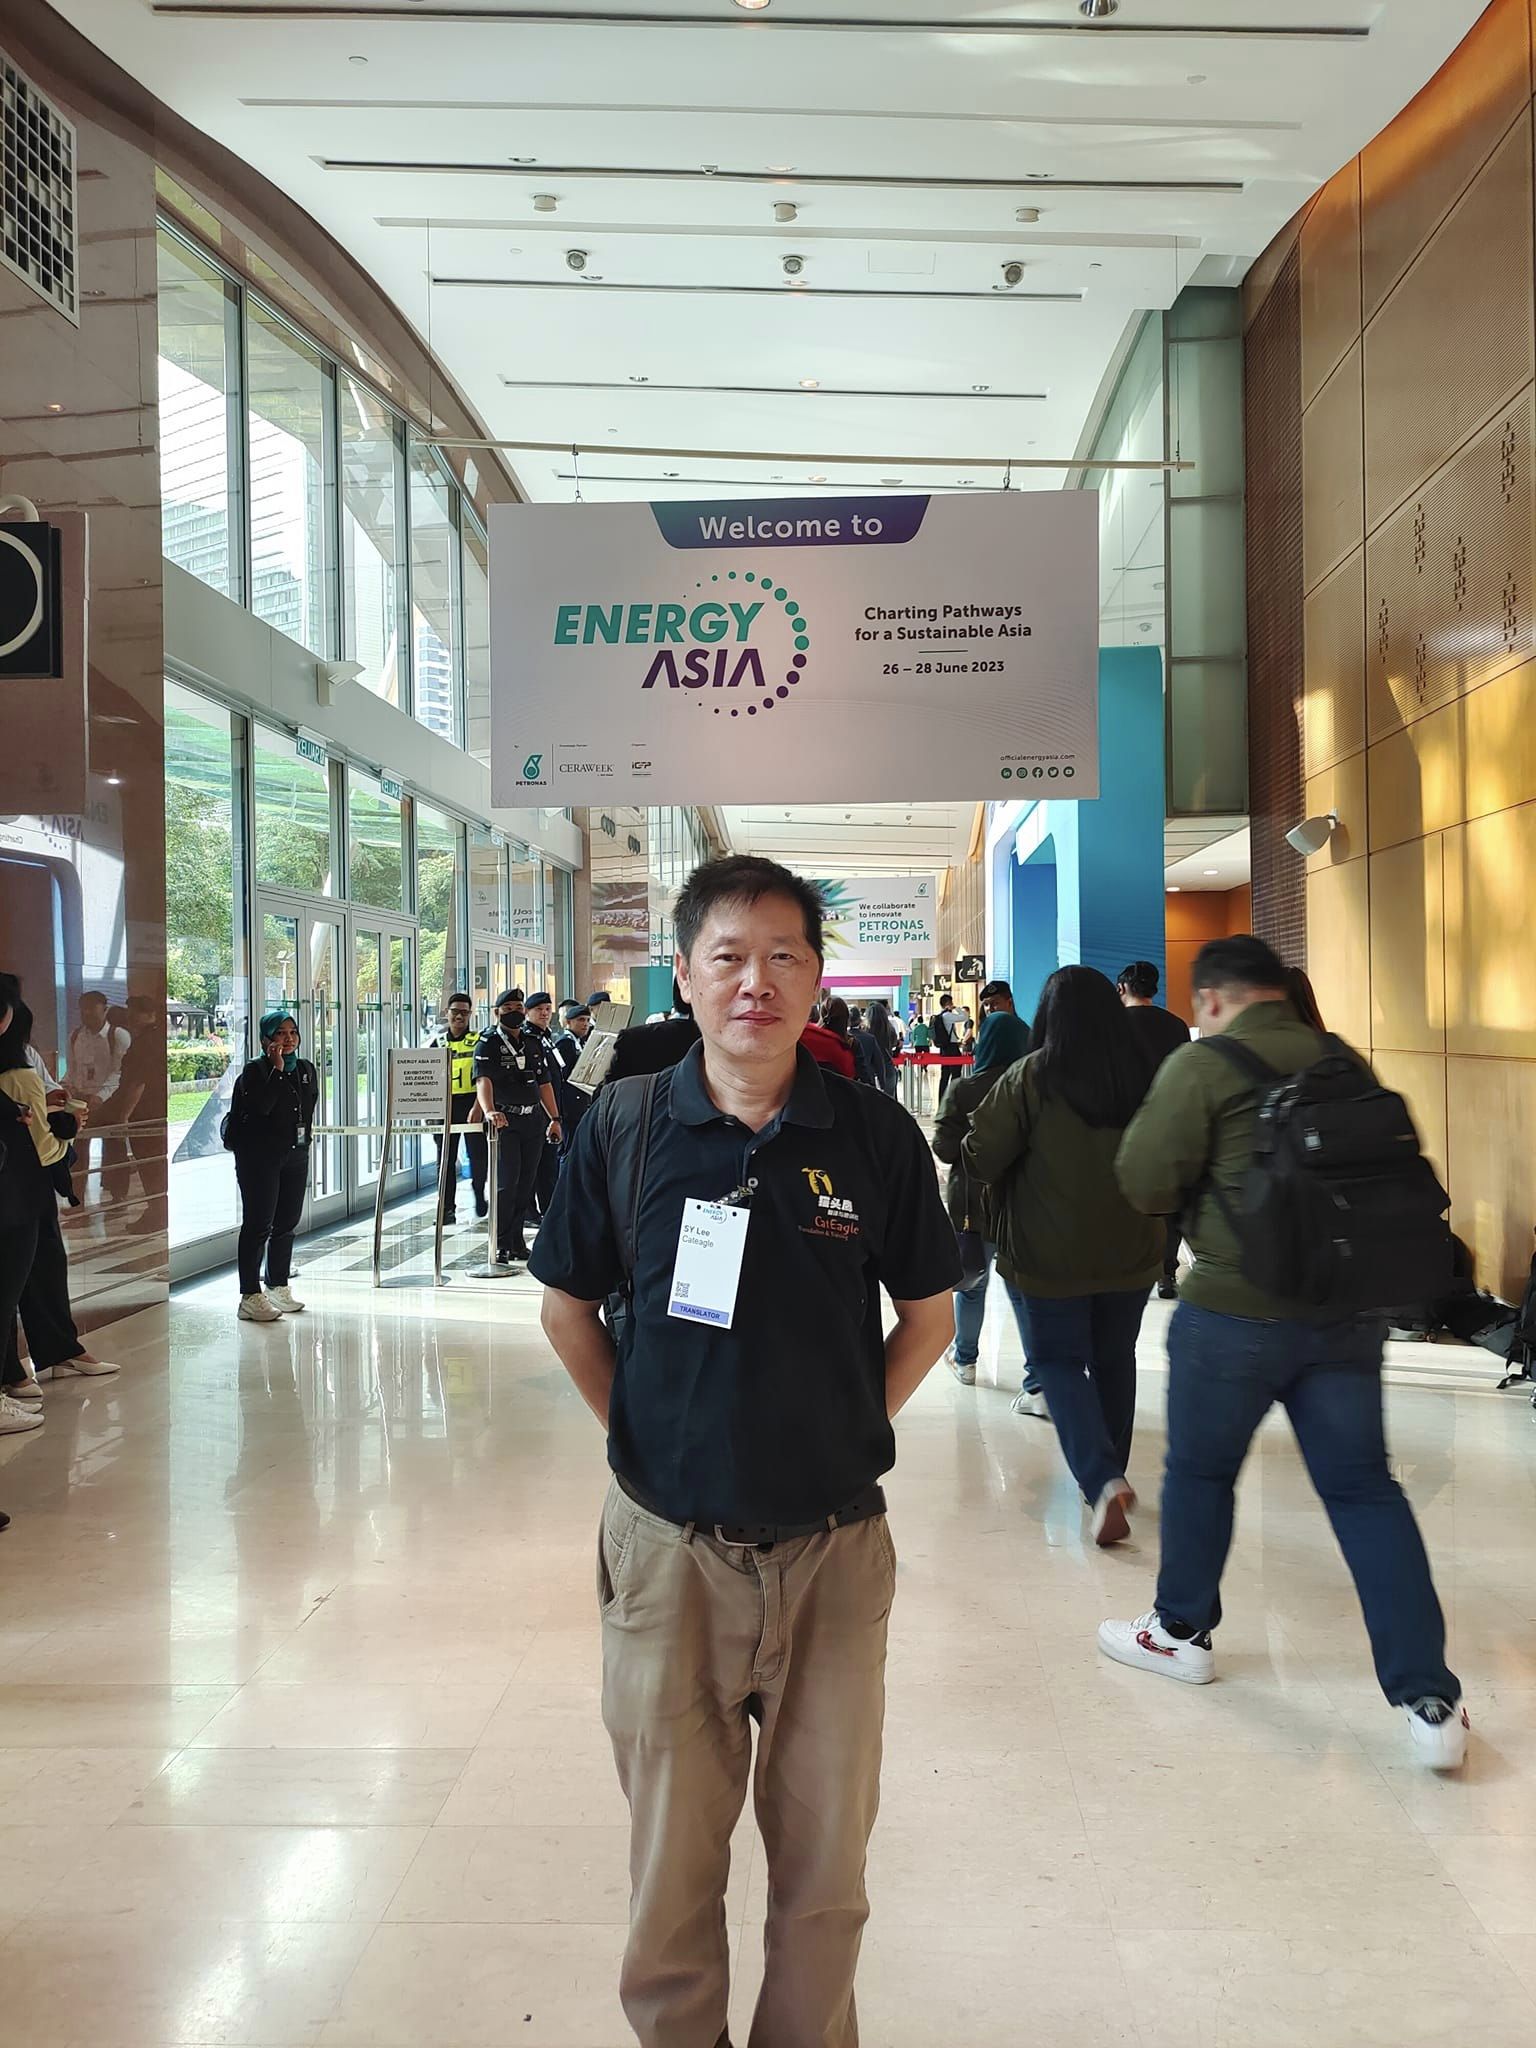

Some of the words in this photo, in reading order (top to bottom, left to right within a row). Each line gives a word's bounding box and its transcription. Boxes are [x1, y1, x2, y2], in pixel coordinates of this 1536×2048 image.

[698, 514, 841, 541] Welcome
[851, 514, 883, 537] to
[864, 606, 938, 621] Charting
[942, 604, 1022, 620] Pathways
[553, 602, 765, 645] ENERGY
[855, 627, 880, 641] for
[883, 630, 893, 640] a
[897, 625, 994, 640] Sustainable
[997, 624, 1032, 638] Asia
[641, 648, 766, 689] ASIA
[882, 663, 900, 675] 26
[915, 663, 932, 674] 28
[935, 662, 969, 674] June
[971, 660, 1005, 673] 2023
[1000, 753, 1076, 761] officialenergyasia.com
[559, 762, 614, 773] CERAWEEK
[859, 920, 924, 931] PETRONAS
[859, 933, 900, 944] Energy
[903, 932, 930, 941] Park
[684, 1224, 695, 1233] SY
[696, 1226, 711, 1237] Lee
[814, 1215, 860, 1236] CatEagle
[682, 1234, 714, 1248] Cateagle
[679, 1304, 721, 1320] TRANSLATOR
